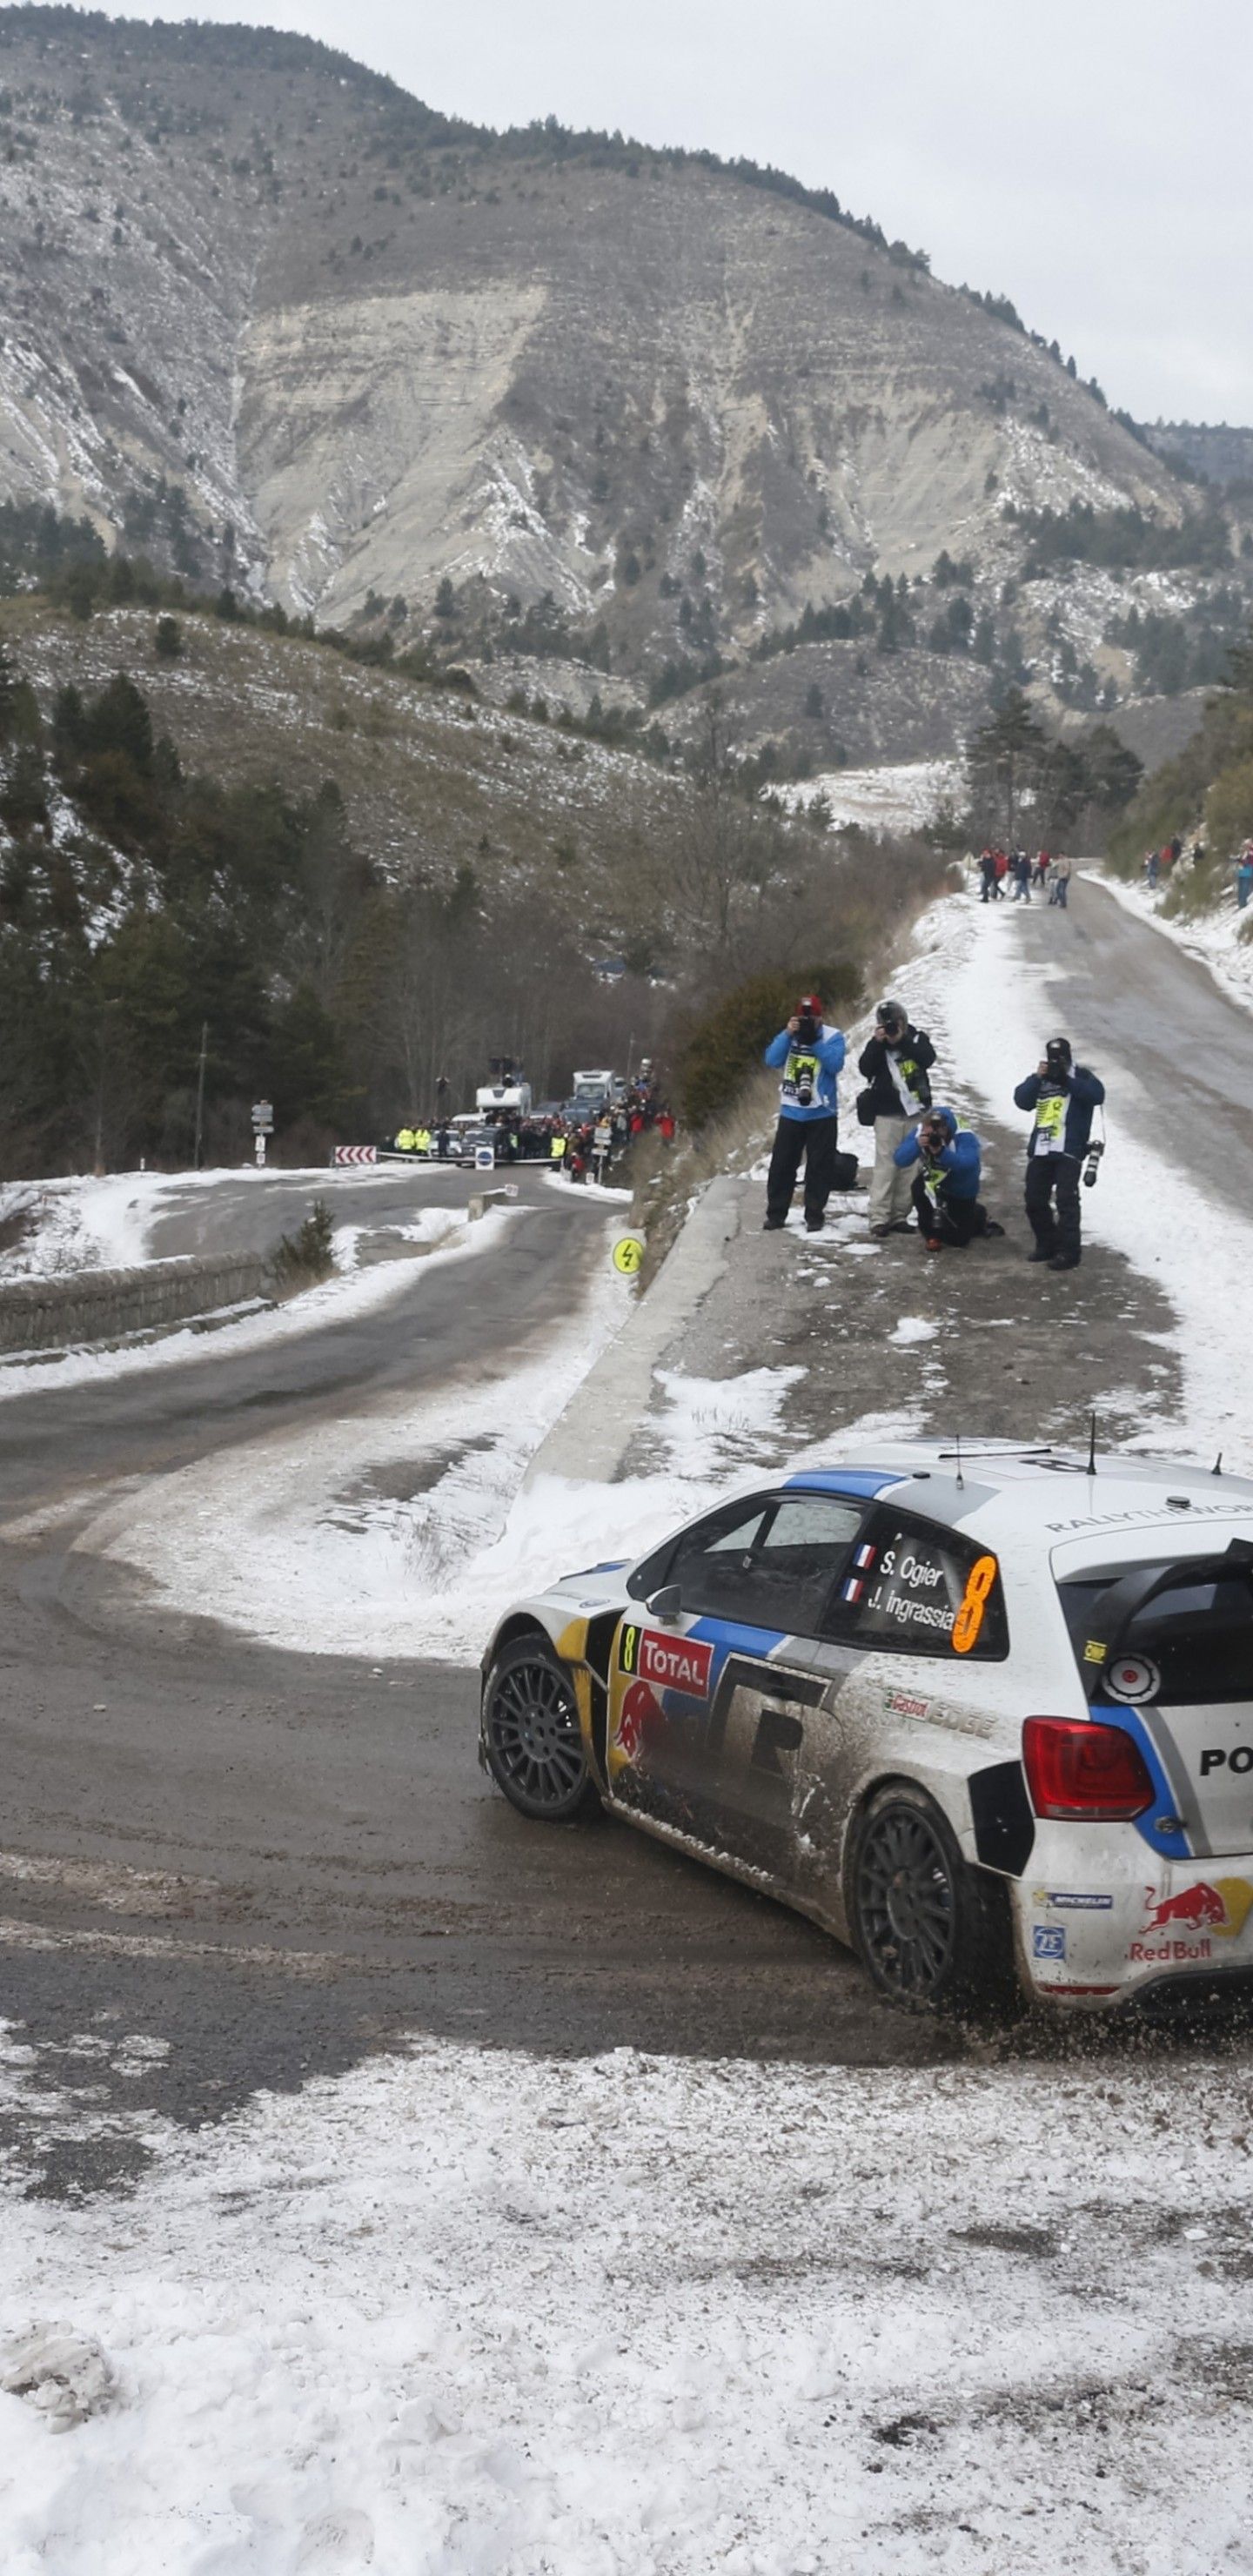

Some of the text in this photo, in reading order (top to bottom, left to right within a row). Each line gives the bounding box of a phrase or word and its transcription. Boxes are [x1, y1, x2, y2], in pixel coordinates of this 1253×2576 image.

[880, 1550, 944, 1588] S. Ogier
[868, 1586, 882, 1610] J.
[952, 1554, 997, 1654] 8
[624, 1627, 635, 1671] 8
[1200, 1746, 1253, 1776] PO
